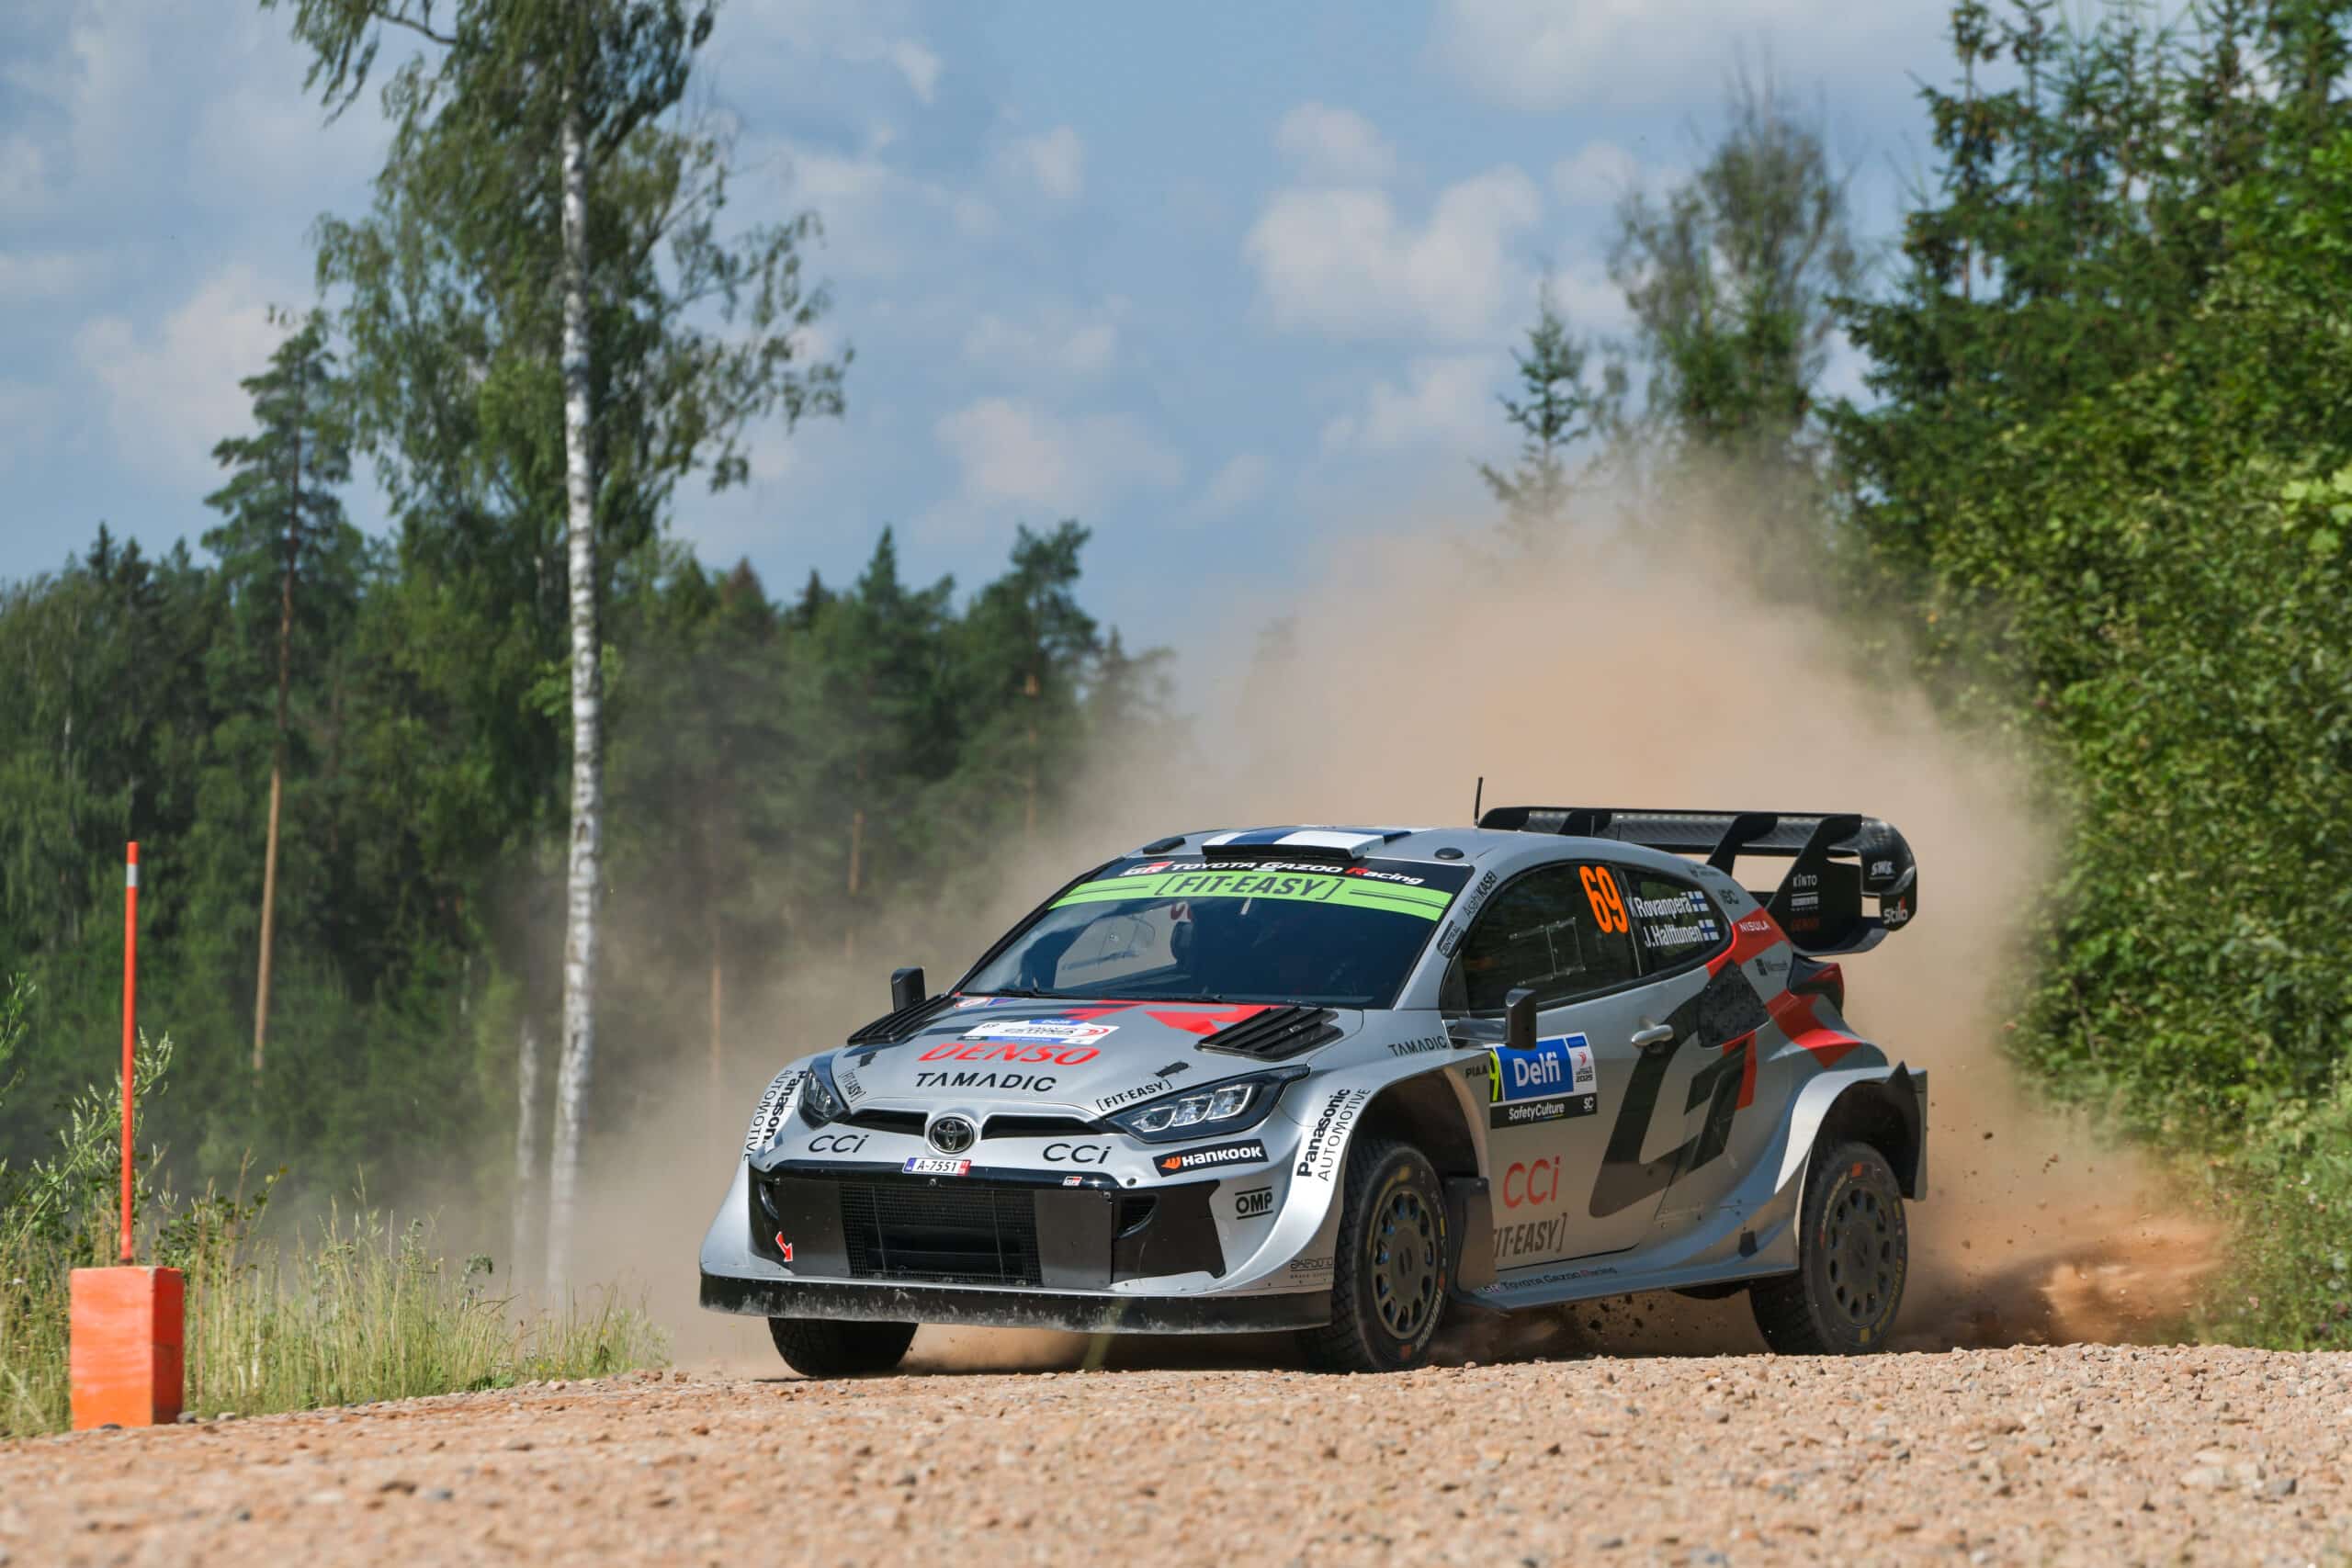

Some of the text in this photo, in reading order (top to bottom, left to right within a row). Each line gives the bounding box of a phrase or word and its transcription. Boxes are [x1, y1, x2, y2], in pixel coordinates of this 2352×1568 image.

[1171, 862, 1257, 872] TOYOTA
[1344, 866, 1426, 886] Racing
[1578, 865, 1630, 934] 69
[918, 1043, 1102, 1066] DENSO
[1388, 1035, 1449, 1056] TAMADIC
[1464, 1065, 1487, 1078] PIAA
[1512, 1051, 1561, 1088] Delfi
[915, 1072, 1057, 1092] TAMADIC
[1508, 1102, 1566, 1122] SafetyCulture
[1296, 1089, 1351, 1178] Panasonic
[1317, 1089, 1371, 1182] AUTOMOTIVE
[917, 1160, 957, 1172] A-7551
[1235, 1192, 1274, 1214] OMP
